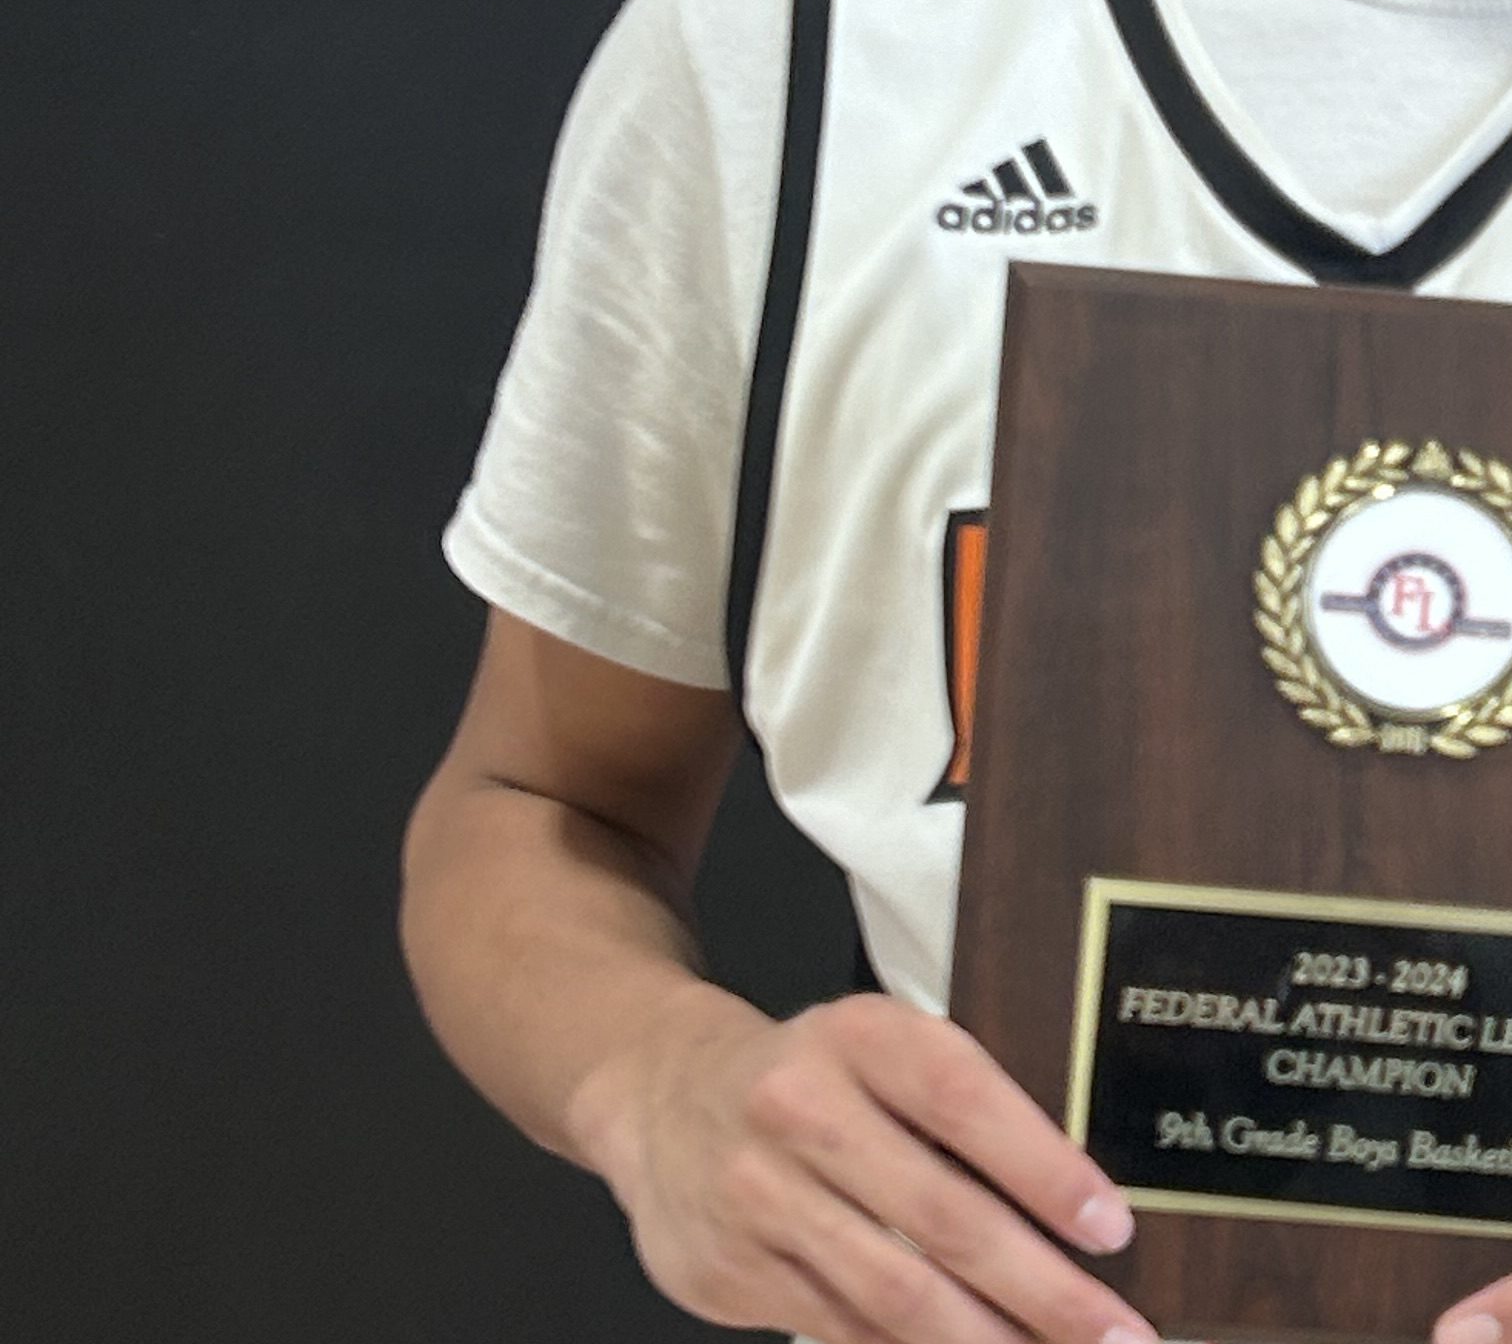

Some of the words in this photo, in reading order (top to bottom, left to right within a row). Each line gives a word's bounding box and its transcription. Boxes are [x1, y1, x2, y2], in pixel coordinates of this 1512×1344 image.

[937, 199, 1098, 234] adidas
[1291, 952, 1370, 990] 2023
[1390, 959, 1470, 1000] 2024
[1118, 985, 1286, 1036] FEDERAL
[1286, 1001, 1477, 1052] ATHLETIC
[1264, 1048, 1477, 1098] CHAMPION
[1155, 1111, 1215, 1152] 9th
[1221, 1116, 1320, 1160] Grade
[1327, 1124, 1399, 1172] Boys
